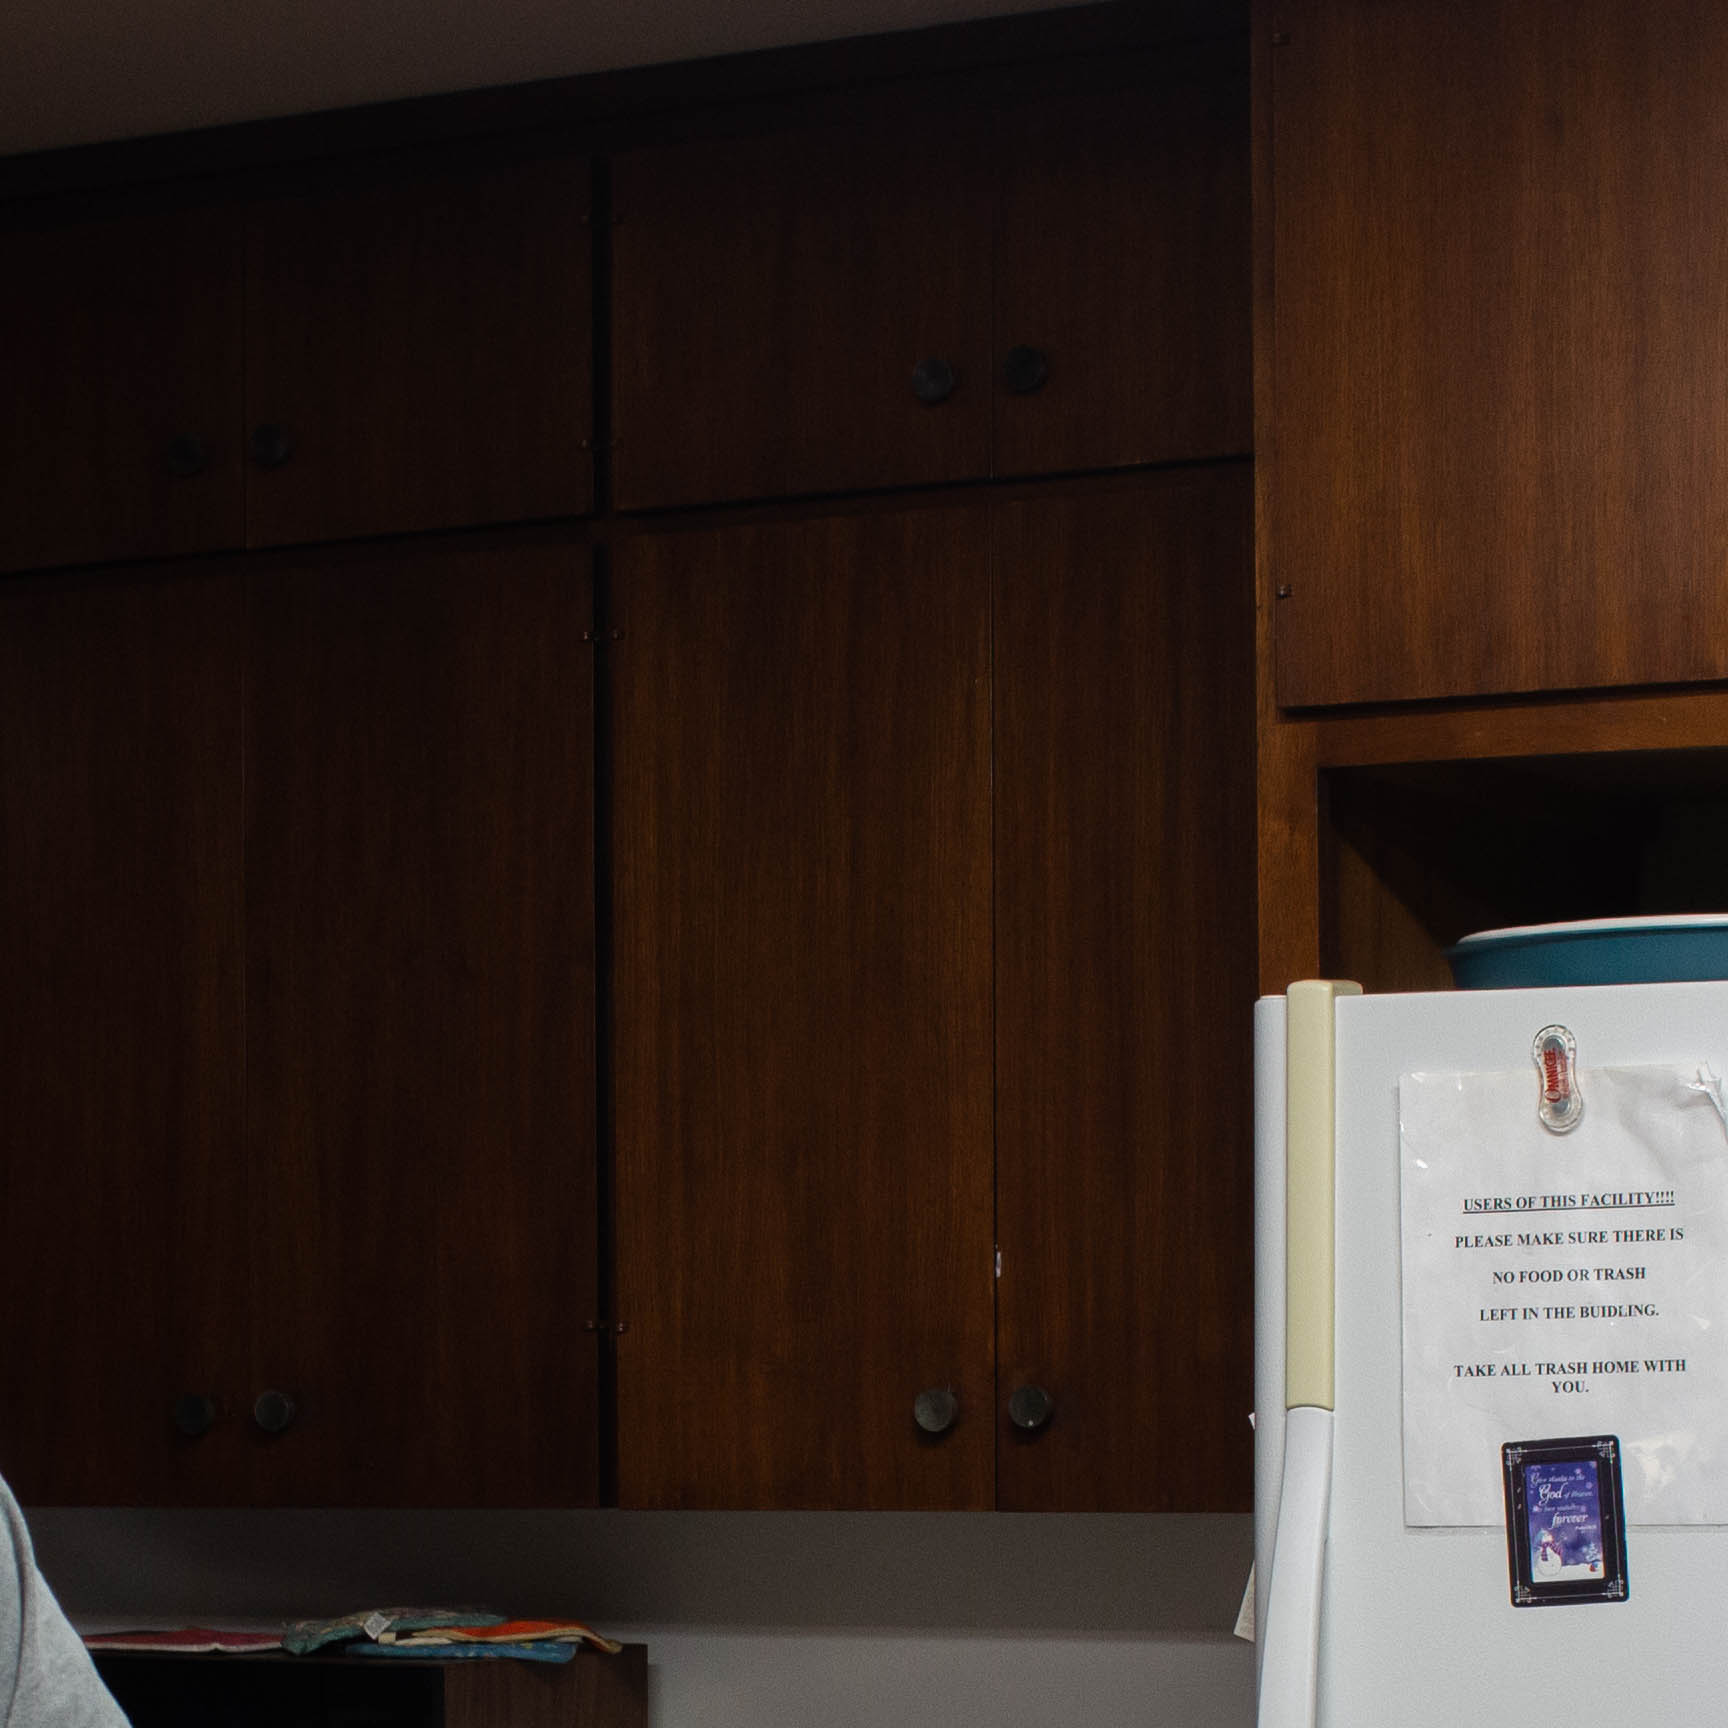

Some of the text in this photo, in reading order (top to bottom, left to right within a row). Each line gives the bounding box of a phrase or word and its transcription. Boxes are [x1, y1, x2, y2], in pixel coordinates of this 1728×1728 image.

[1463, 1191, 1674, 1212] USERS OF THIS FACILITY!!!!
[1454, 1227, 1684, 1249] PLEASE MAKE SURE THERE IS
[1492, 1266, 1647, 1285] NO FOOD OR TRASH
[1479, 1303, 1660, 1321] LEFT IN THE BUIDLING.
[1454, 1359, 1687, 1378] TAKE ALL TRASH HOME WITH
[1551, 1380, 1590, 1394] YOU.
[1537, 1481, 1569, 1506] God
